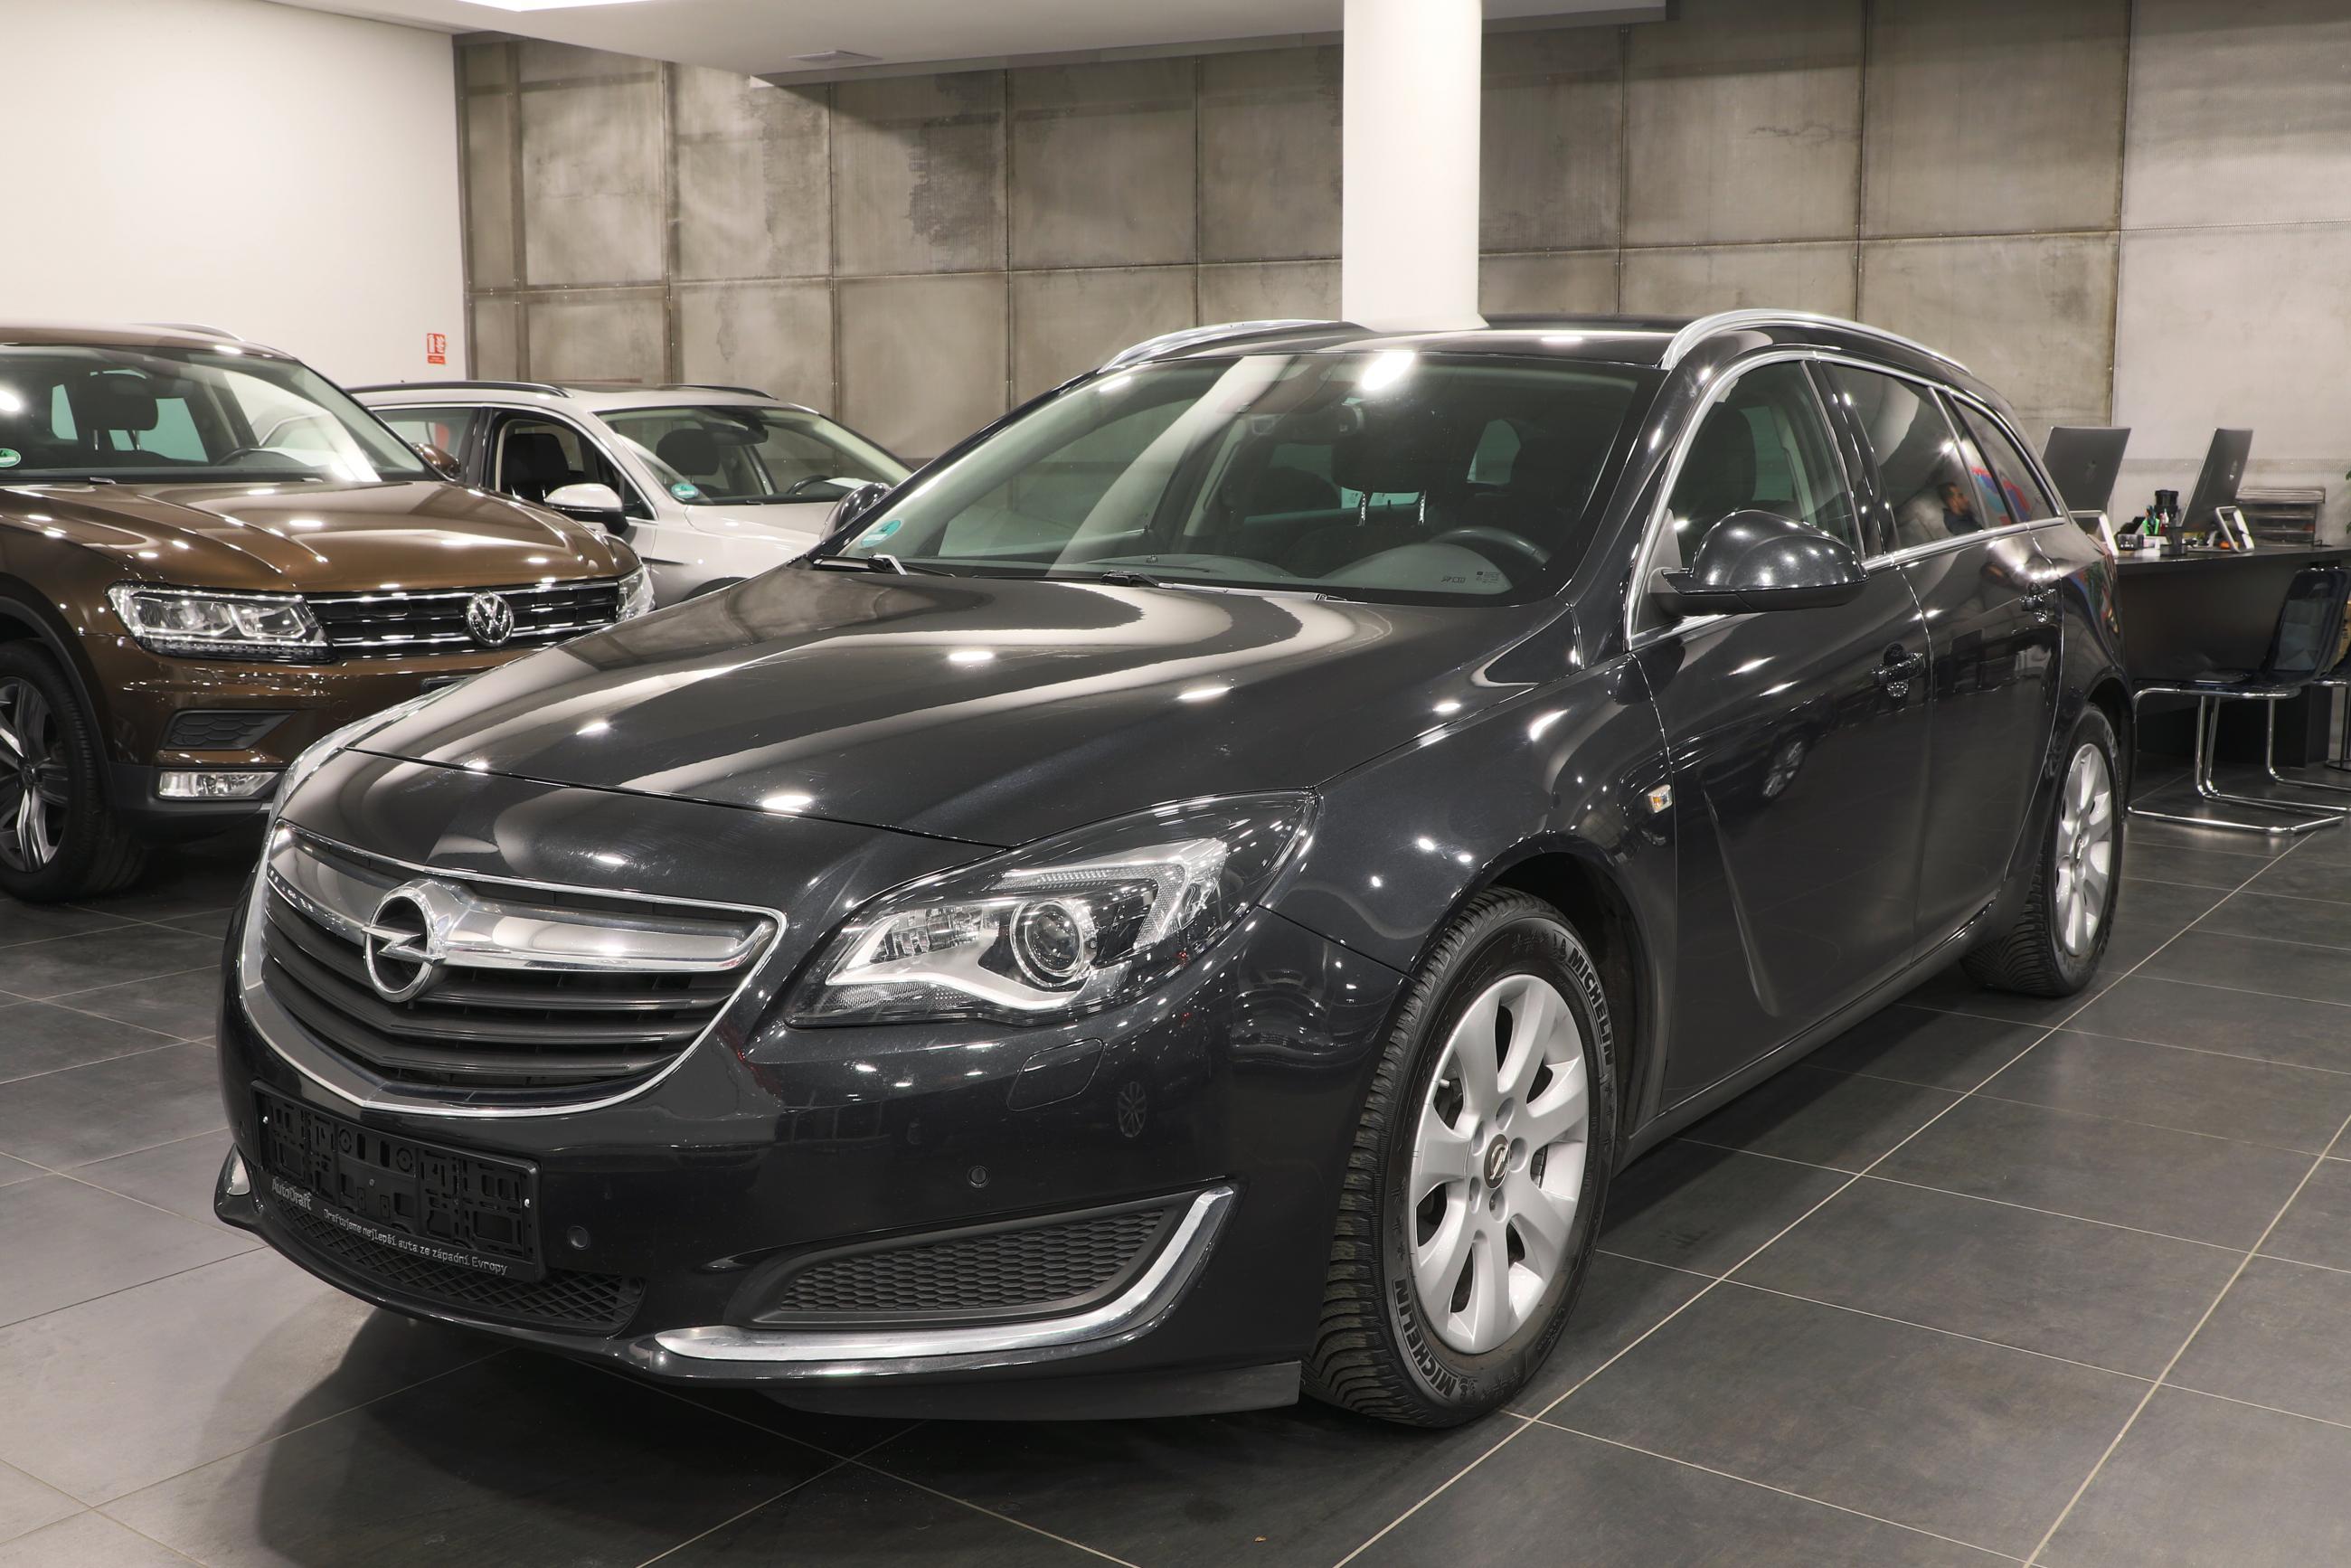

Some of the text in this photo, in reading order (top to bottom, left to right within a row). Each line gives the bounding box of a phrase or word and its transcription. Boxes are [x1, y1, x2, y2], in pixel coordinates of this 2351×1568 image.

[1568, 947, 1615, 1066] MICHELIN
[363, 1227, 397, 1246] nejlepší
[398, 1240, 419, 1252] auta
[420, 1246, 431, 1256] ze
[432, 1248, 470, 1266] západní
[471, 1256, 507, 1276] Evropy
[1393, 1279, 1458, 1397] MICHELIN
